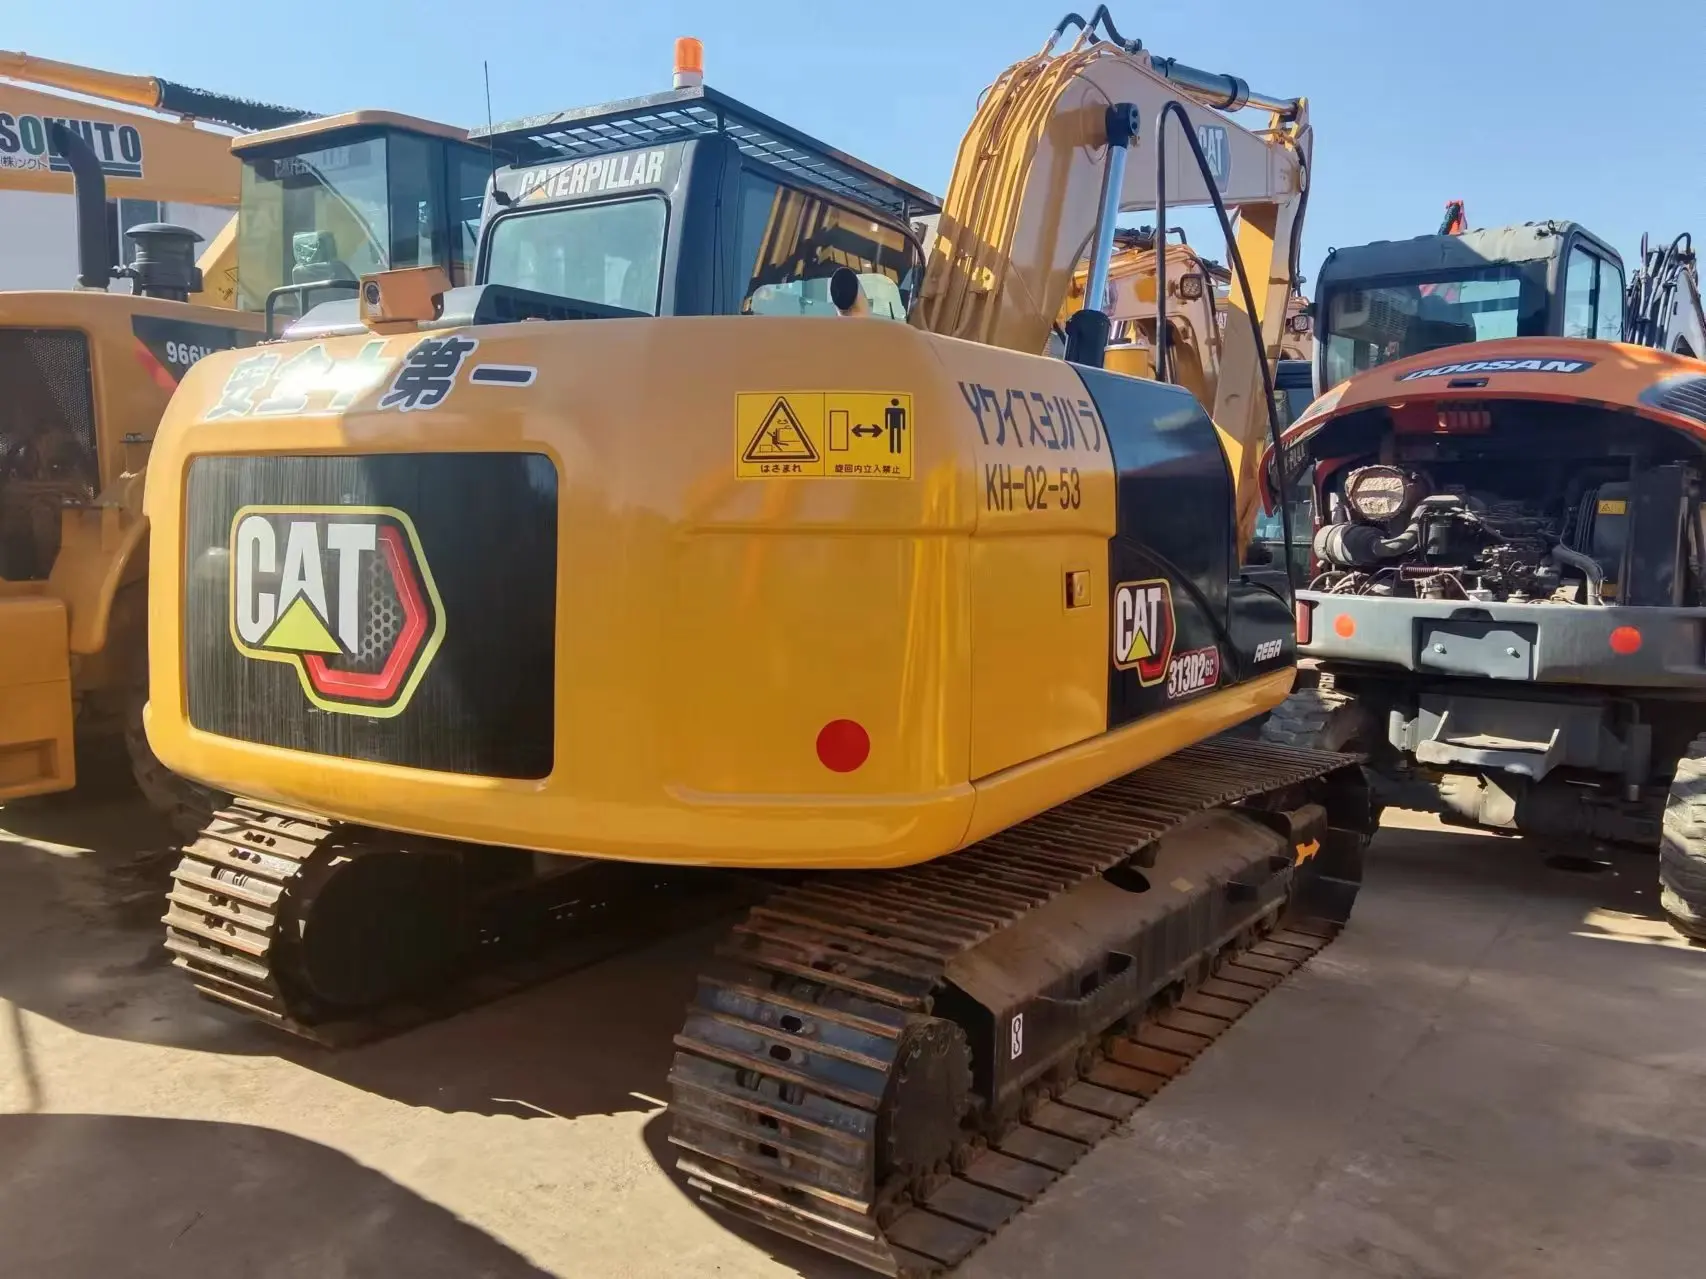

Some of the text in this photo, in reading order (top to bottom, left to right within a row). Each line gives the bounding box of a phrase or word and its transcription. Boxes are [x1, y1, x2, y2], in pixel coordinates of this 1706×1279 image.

[520, 151, 665, 197] CATERPILLAR
[1401, 360, 1582, 381] DOOSAN
[761, 464, 801, 473] はさまれ
[985, 464, 1081, 511] KH-02-53
[237, 516, 376, 654] CAT
[1116, 588, 1162, 662] CAT
